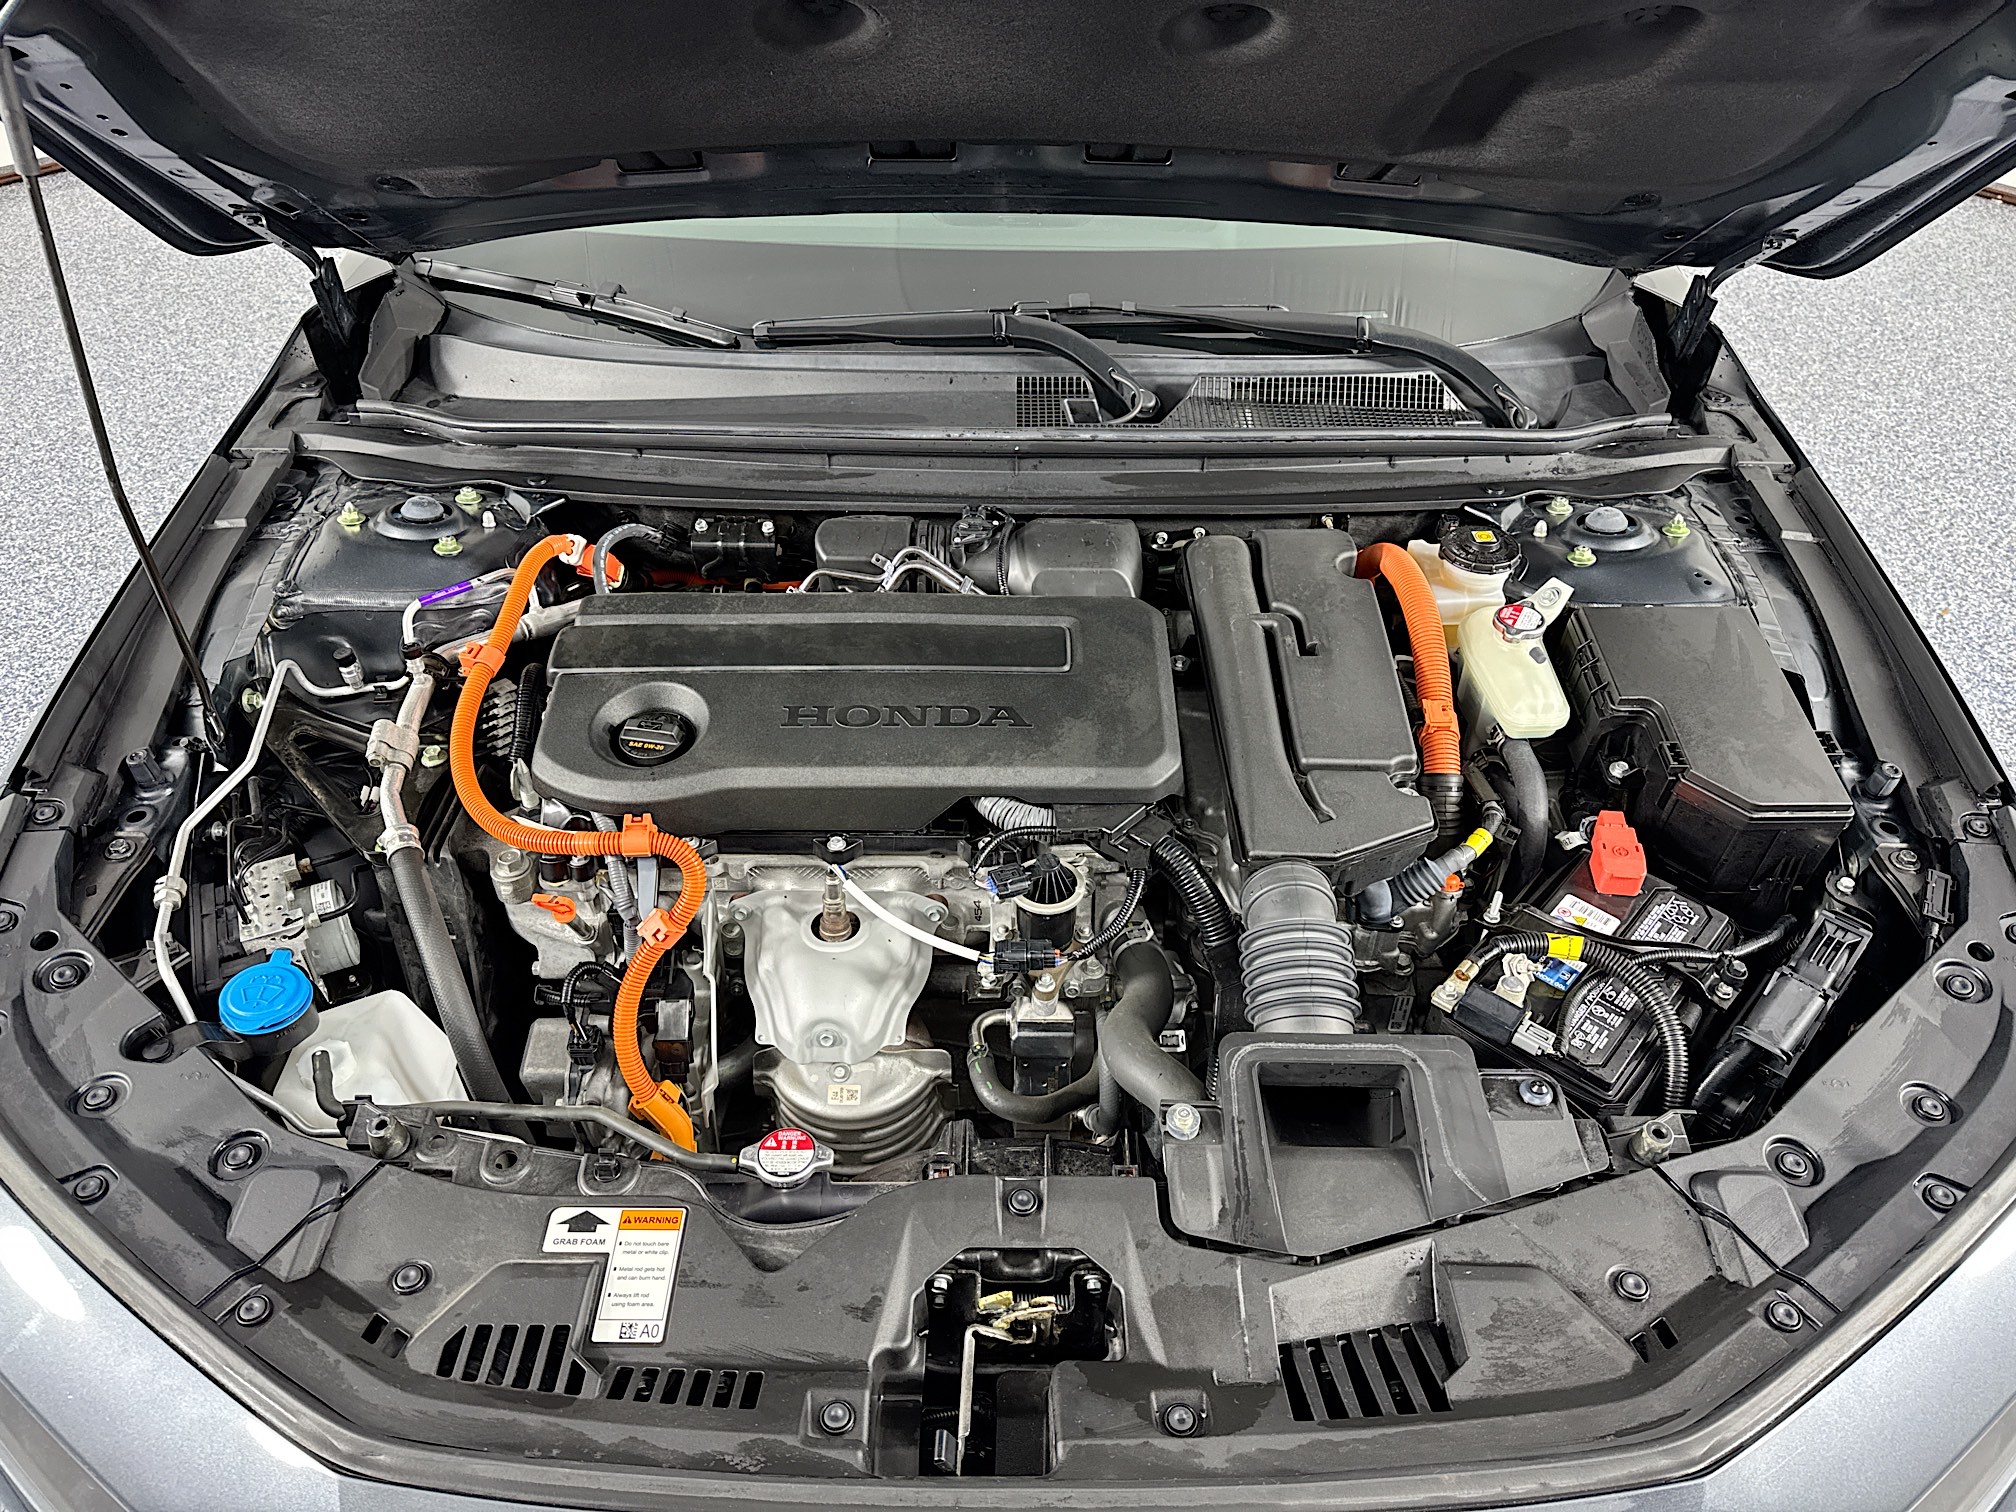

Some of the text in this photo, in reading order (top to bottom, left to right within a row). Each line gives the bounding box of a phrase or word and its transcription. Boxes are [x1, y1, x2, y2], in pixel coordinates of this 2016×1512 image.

[780, 704, 1034, 729] HONDA
[643, 743, 665, 751] 0W-20
[973, 900, 983, 922] 454
[634, 1216, 679, 1224] WARNING
[639, 1324, 660, 1338] A0
